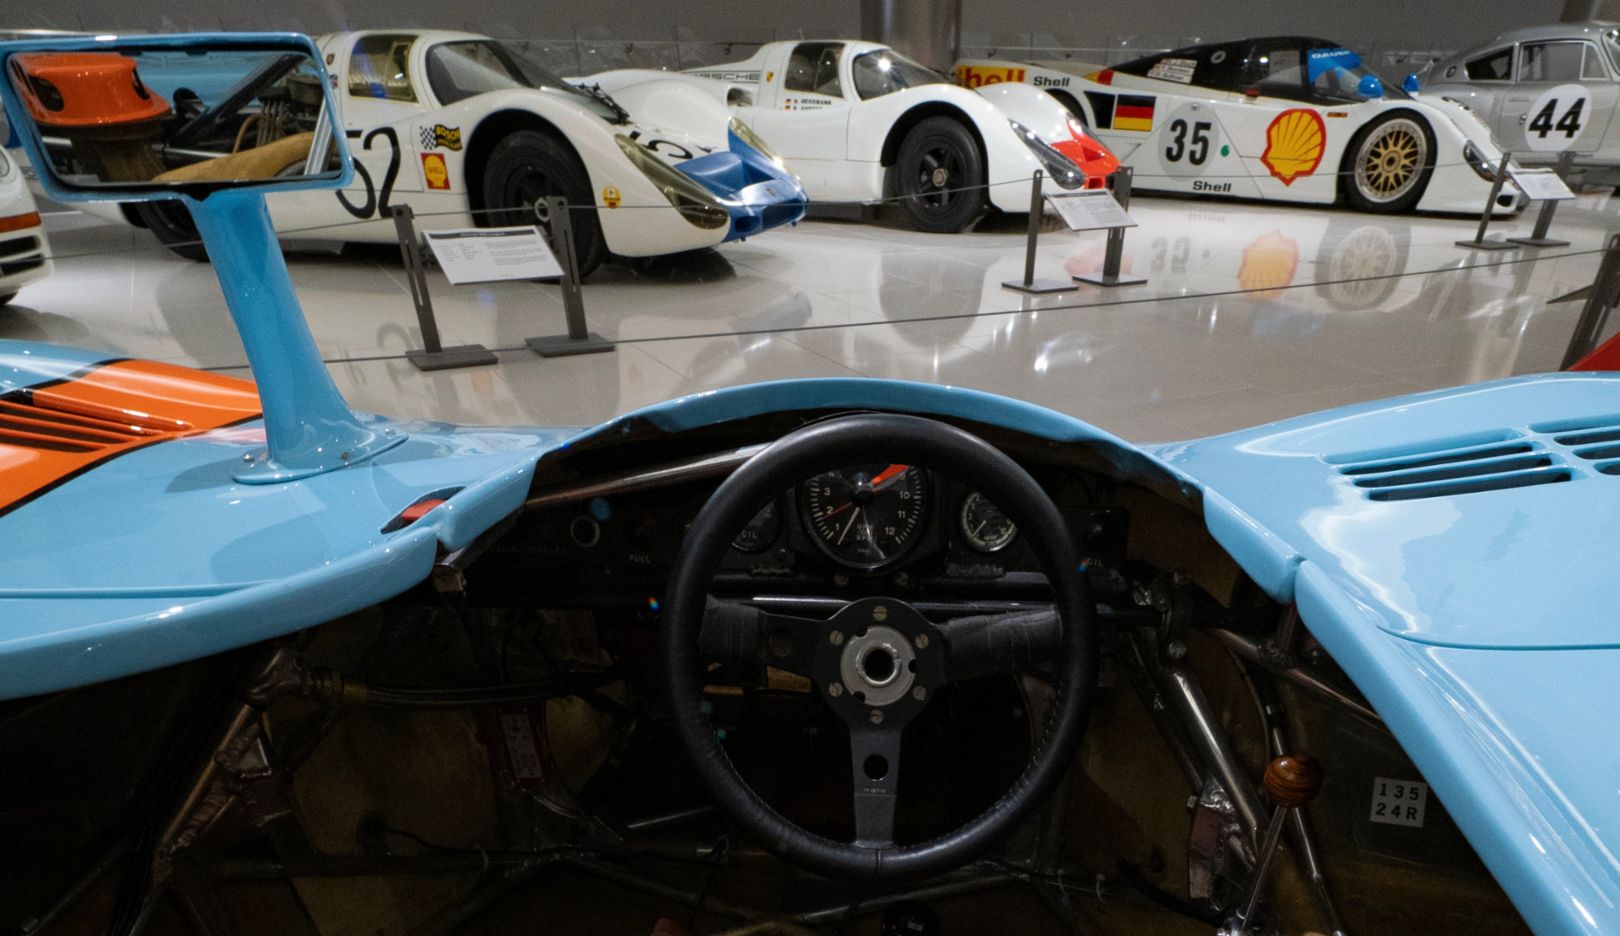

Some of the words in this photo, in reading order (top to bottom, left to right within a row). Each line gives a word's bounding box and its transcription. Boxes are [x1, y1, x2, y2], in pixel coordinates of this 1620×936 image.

[957, 67, 1025, 88] hell
[1033, 75, 1070, 87] Shell
[1528, 97, 1586, 138] 44
[1165, 119, 1212, 165] 35
[1193, 180, 1232, 193] Shell
[824, 487, 831, 496] 3
[899, 490, 910, 500] 10
[826, 506, 834, 514] 2
[897, 510, 906, 518] 11
[885, 526, 896, 535] 12
